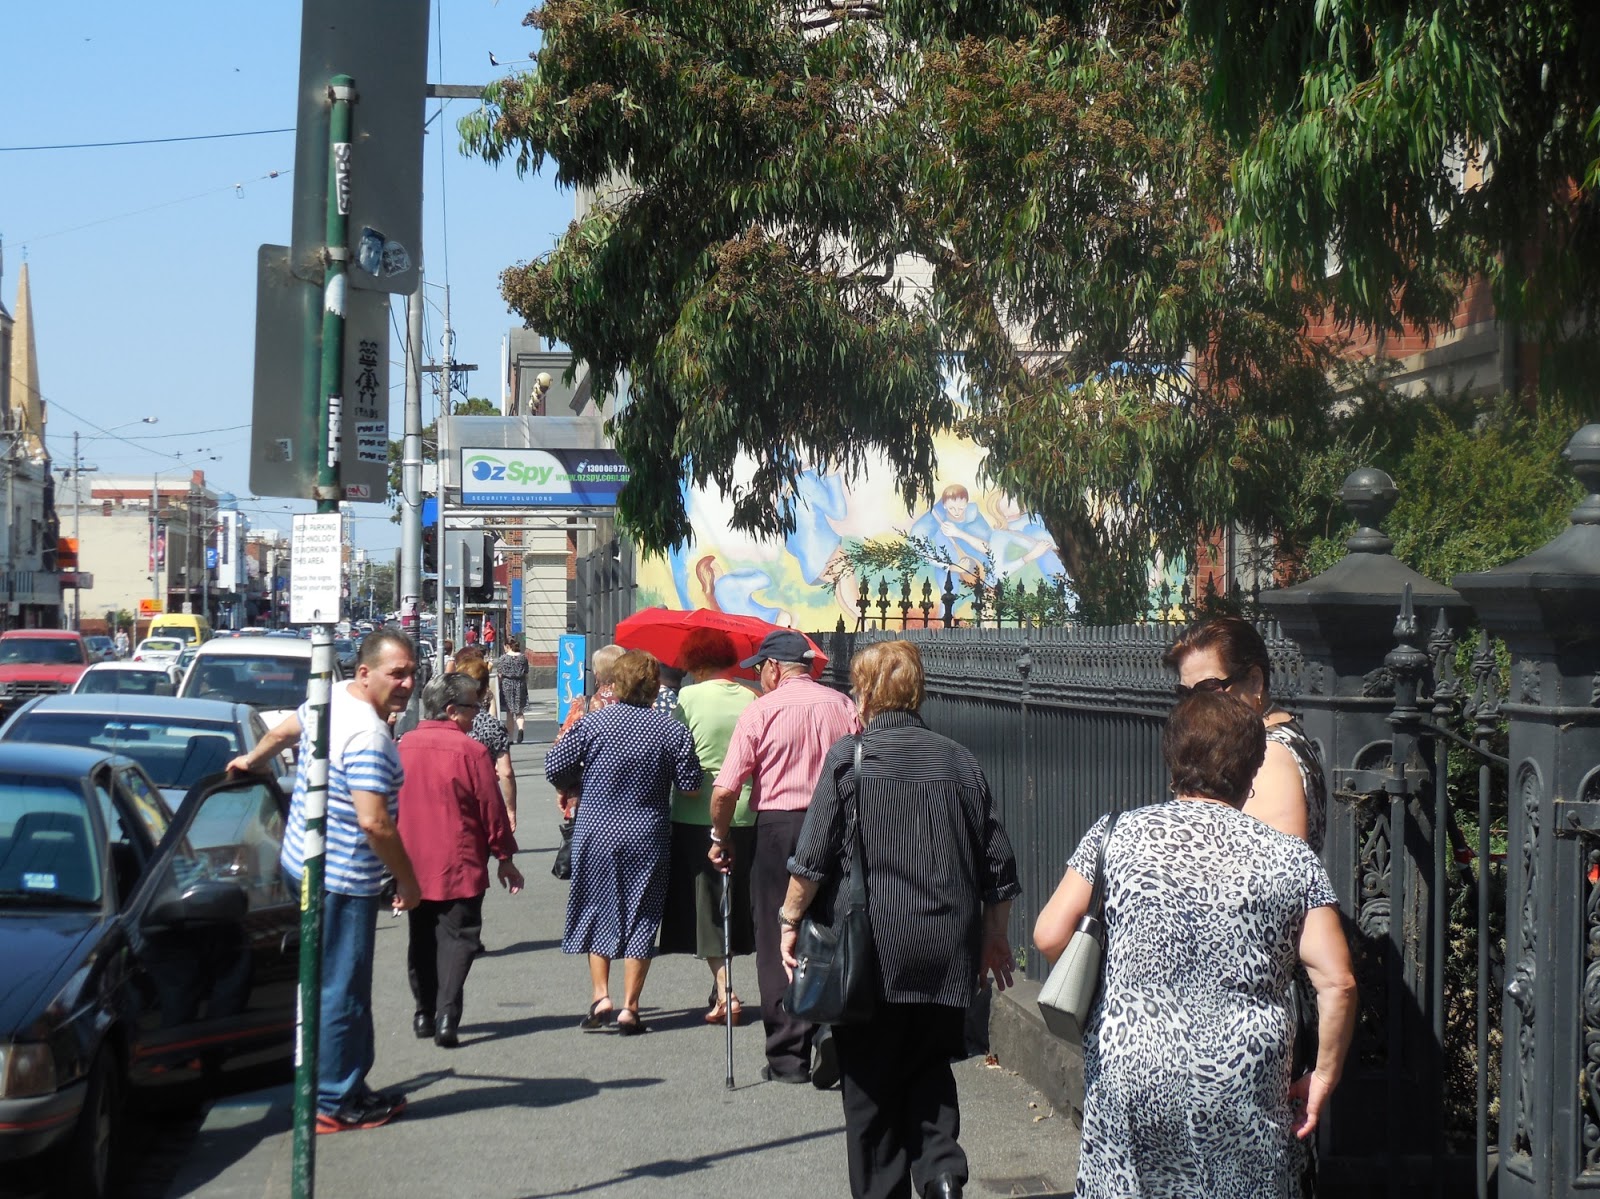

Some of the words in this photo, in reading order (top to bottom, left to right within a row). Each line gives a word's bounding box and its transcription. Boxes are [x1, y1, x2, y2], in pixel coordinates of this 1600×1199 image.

[472, 461, 554, 485] OzSpy
[555, 474, 630, 483] www.ozspy.com.au
[310, 523, 337, 531] PARKING
[294, 535, 336, 543] TECHNOLOGY
[301, 545, 330, 553] WORKING
[331, 545, 338, 553] IN
[294, 557, 307, 565] THIS
[308, 557, 325, 565] AREA
